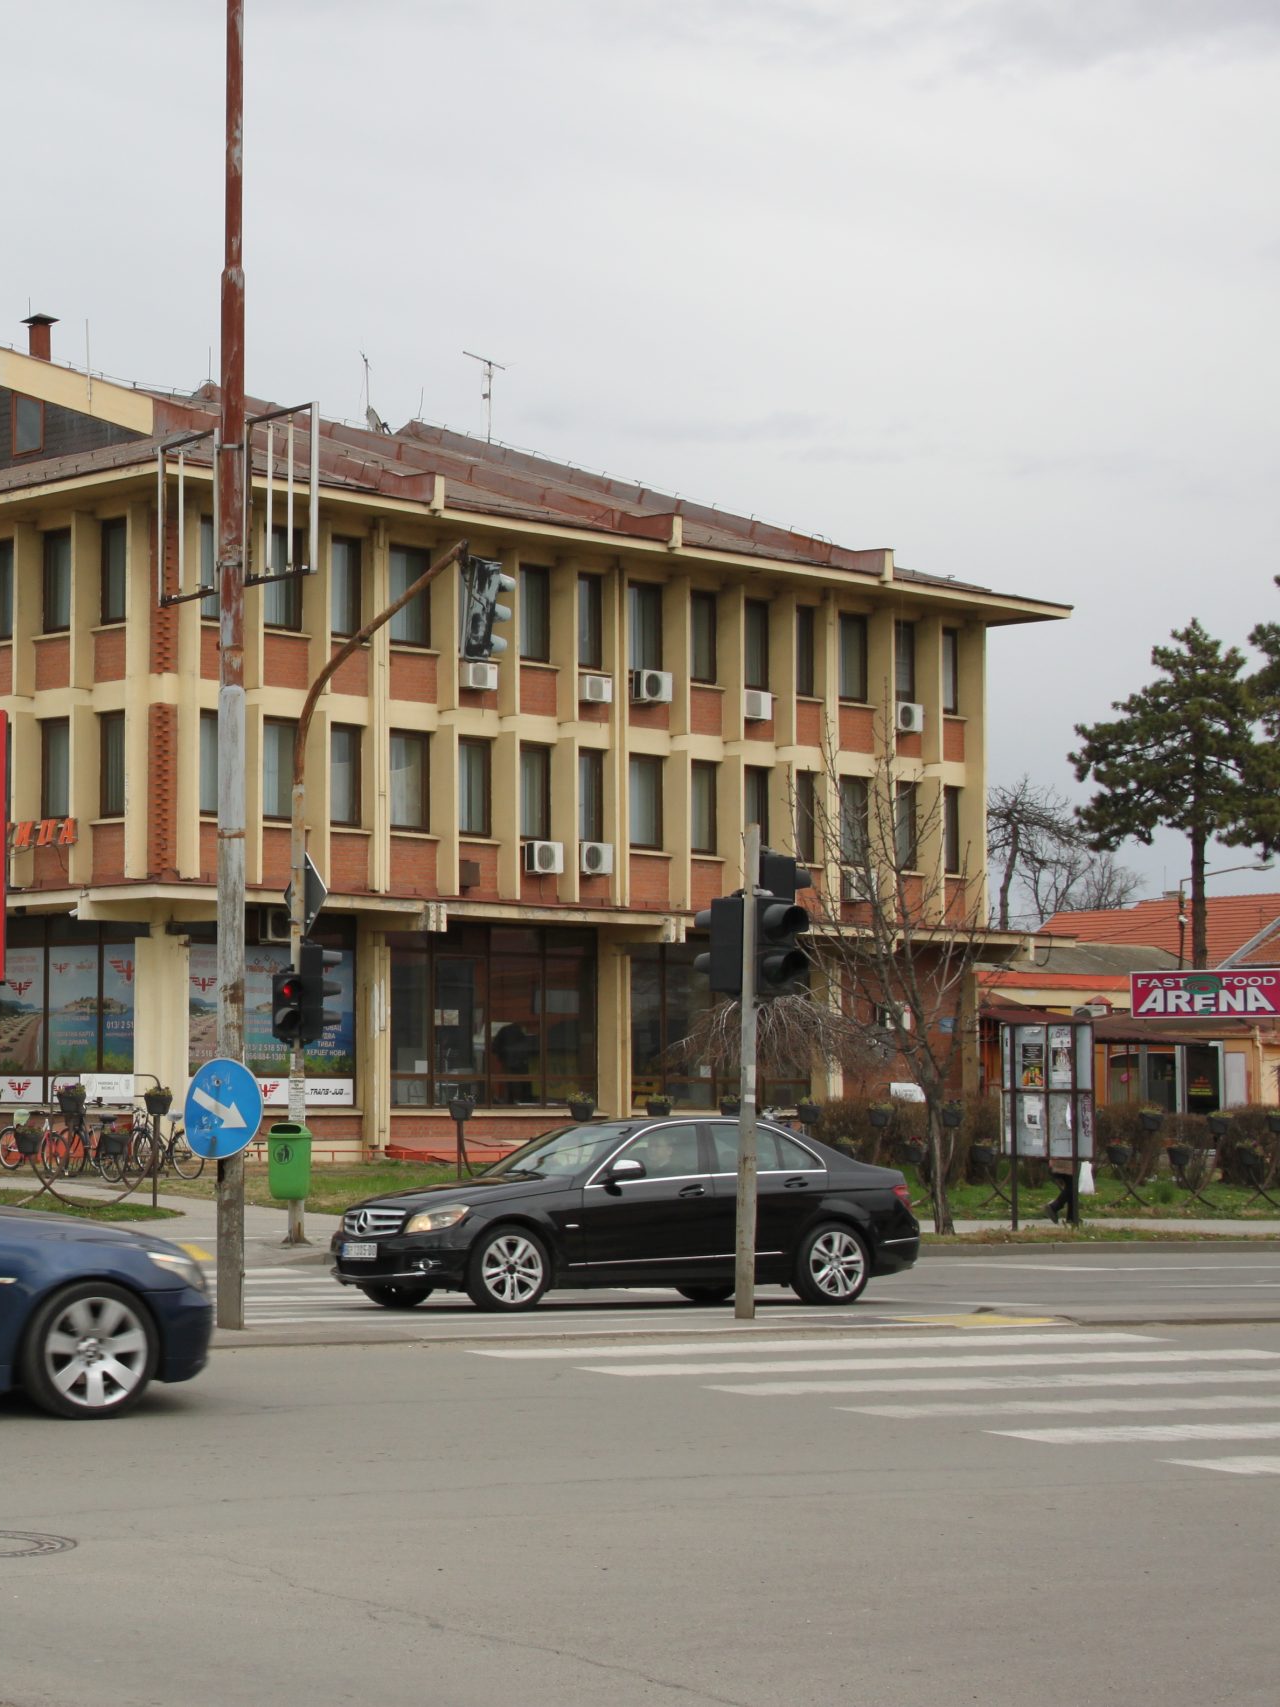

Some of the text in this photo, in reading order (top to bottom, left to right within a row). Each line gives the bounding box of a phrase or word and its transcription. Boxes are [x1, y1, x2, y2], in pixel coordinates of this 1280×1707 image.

[1137, 976, 1277, 988] FAST FOOD
[1137, 986, 1276, 1013] ARENA
